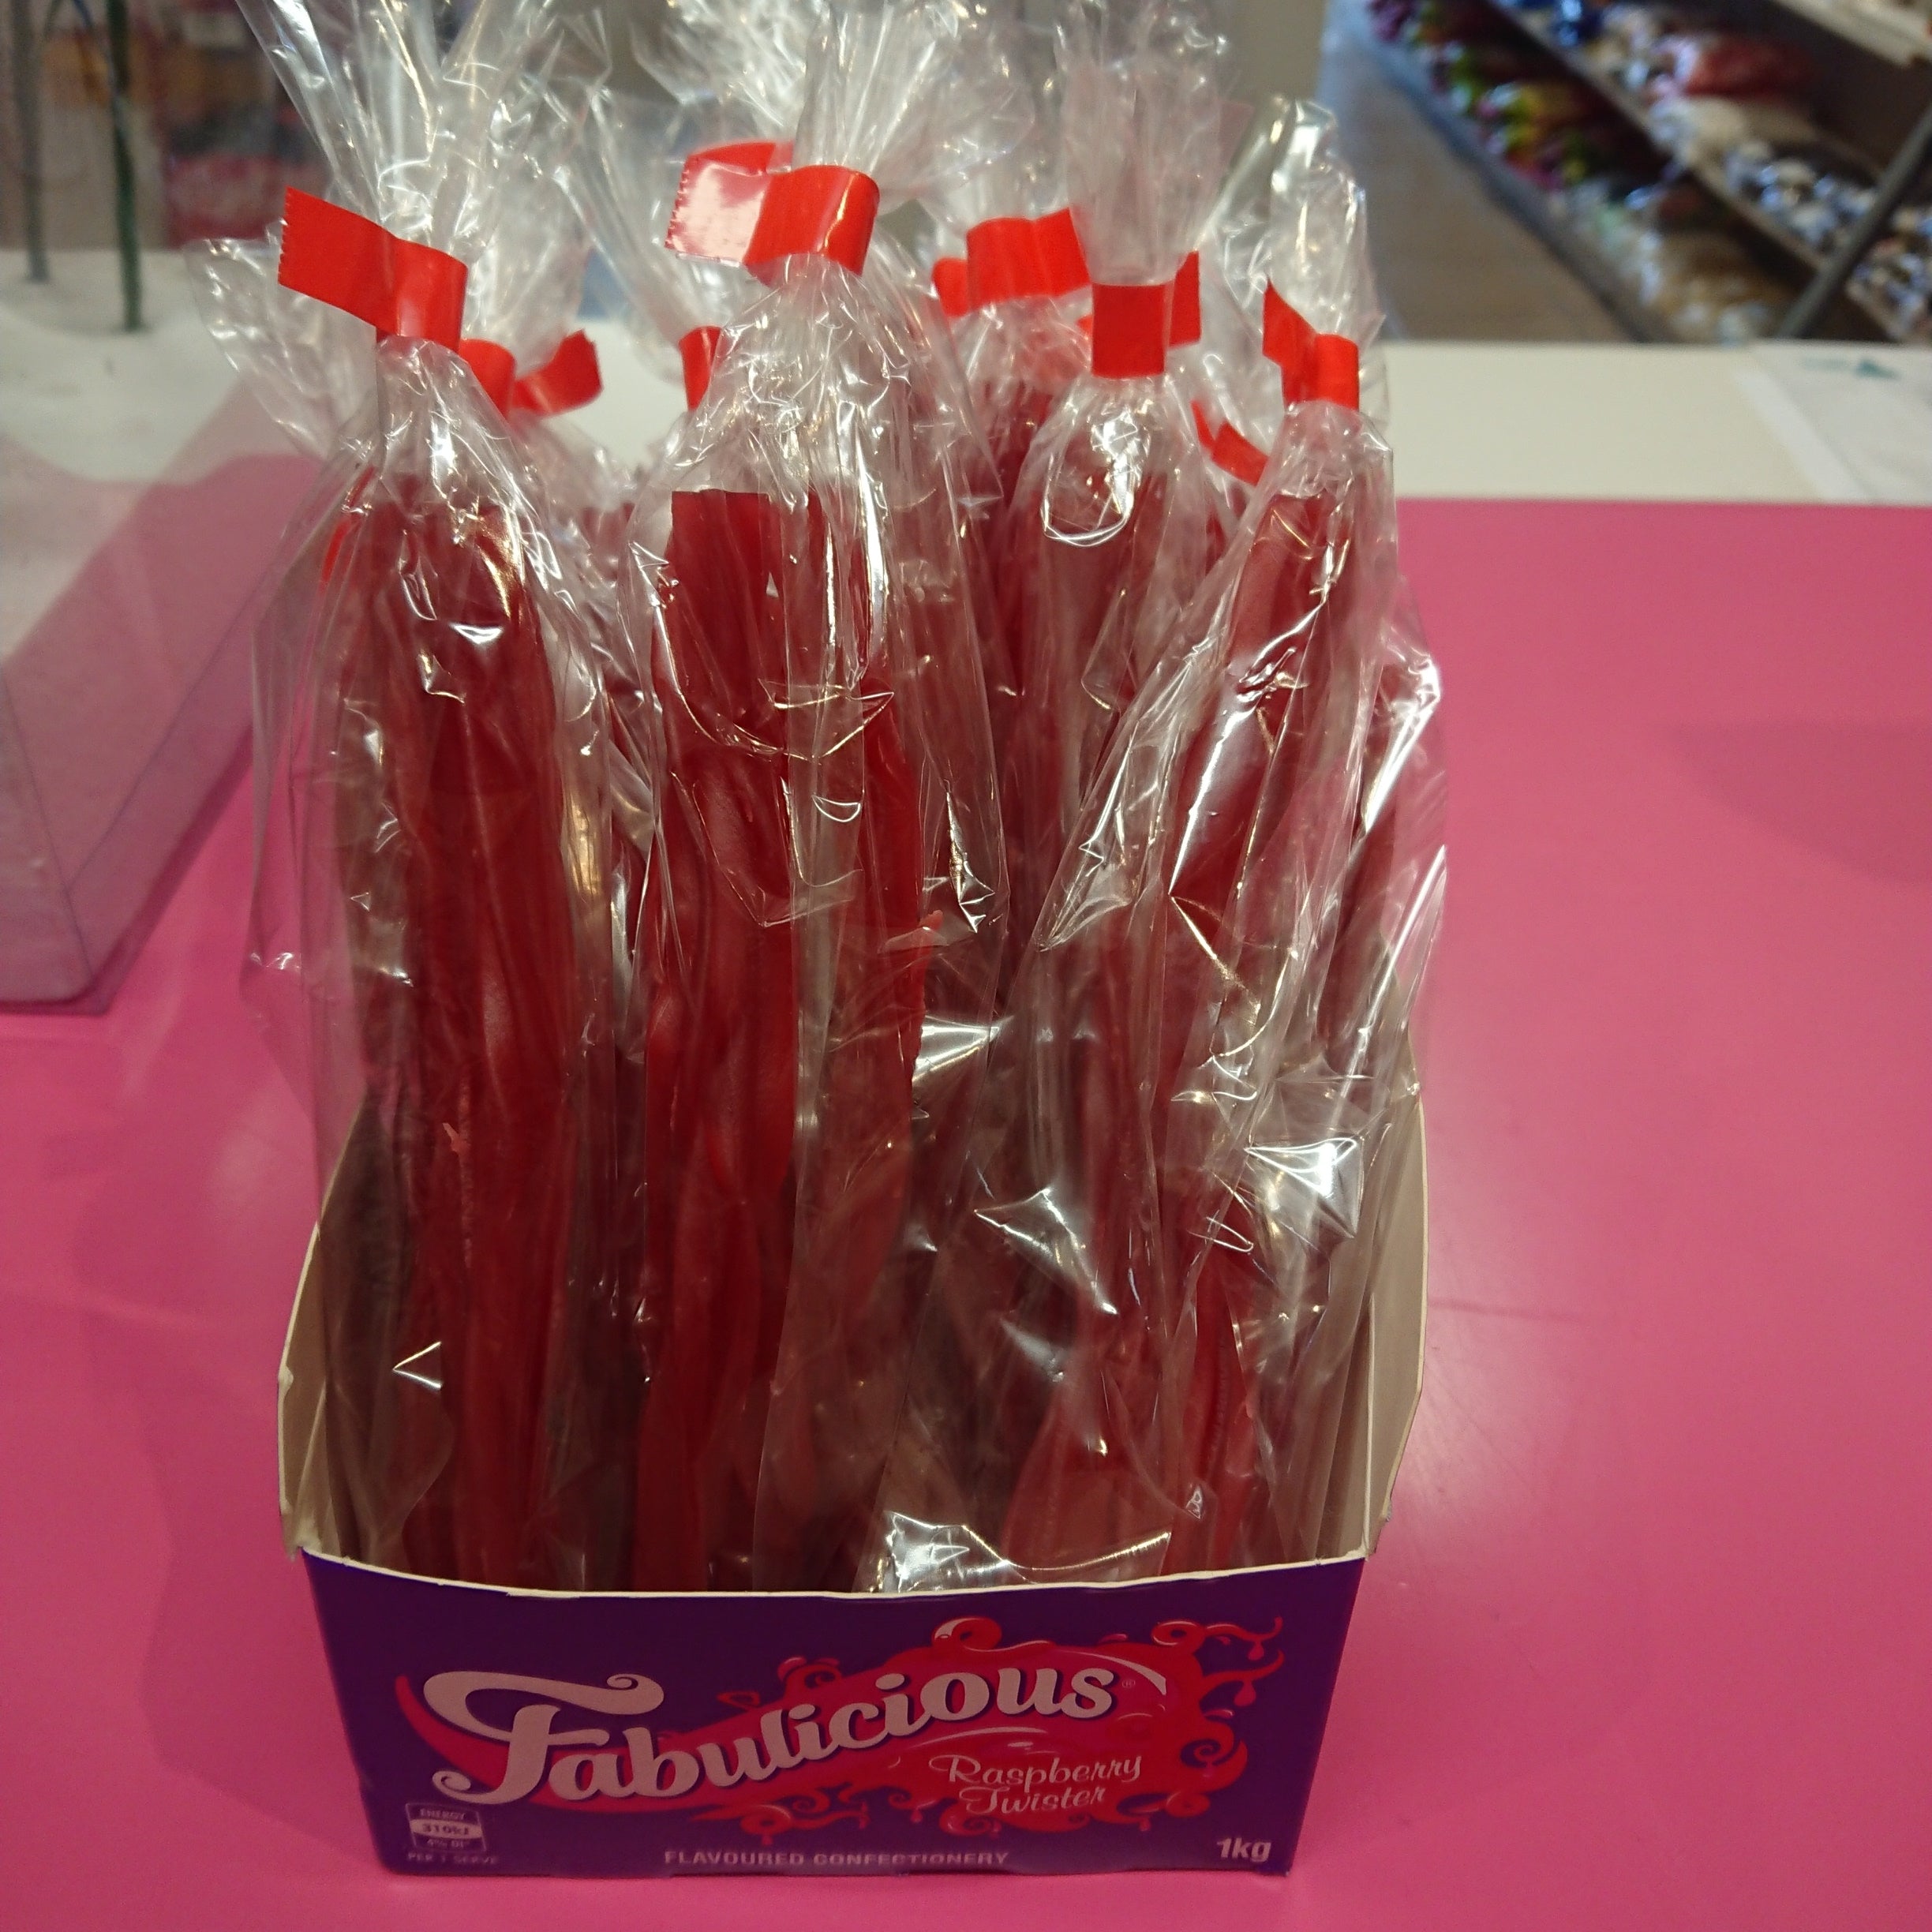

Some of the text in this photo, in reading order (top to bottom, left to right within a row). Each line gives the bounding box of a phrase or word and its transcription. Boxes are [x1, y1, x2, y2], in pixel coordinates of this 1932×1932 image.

[424, 1666, 1115, 1803] Fabulicious
[928, 1754, 1143, 1792] Raspberry
[959, 1786, 1106, 1815] Twister
[665, 1851, 1009, 1866] FLAVOURED CONFECTIONERY
[1216, 1837, 1272, 1863] 1kg
